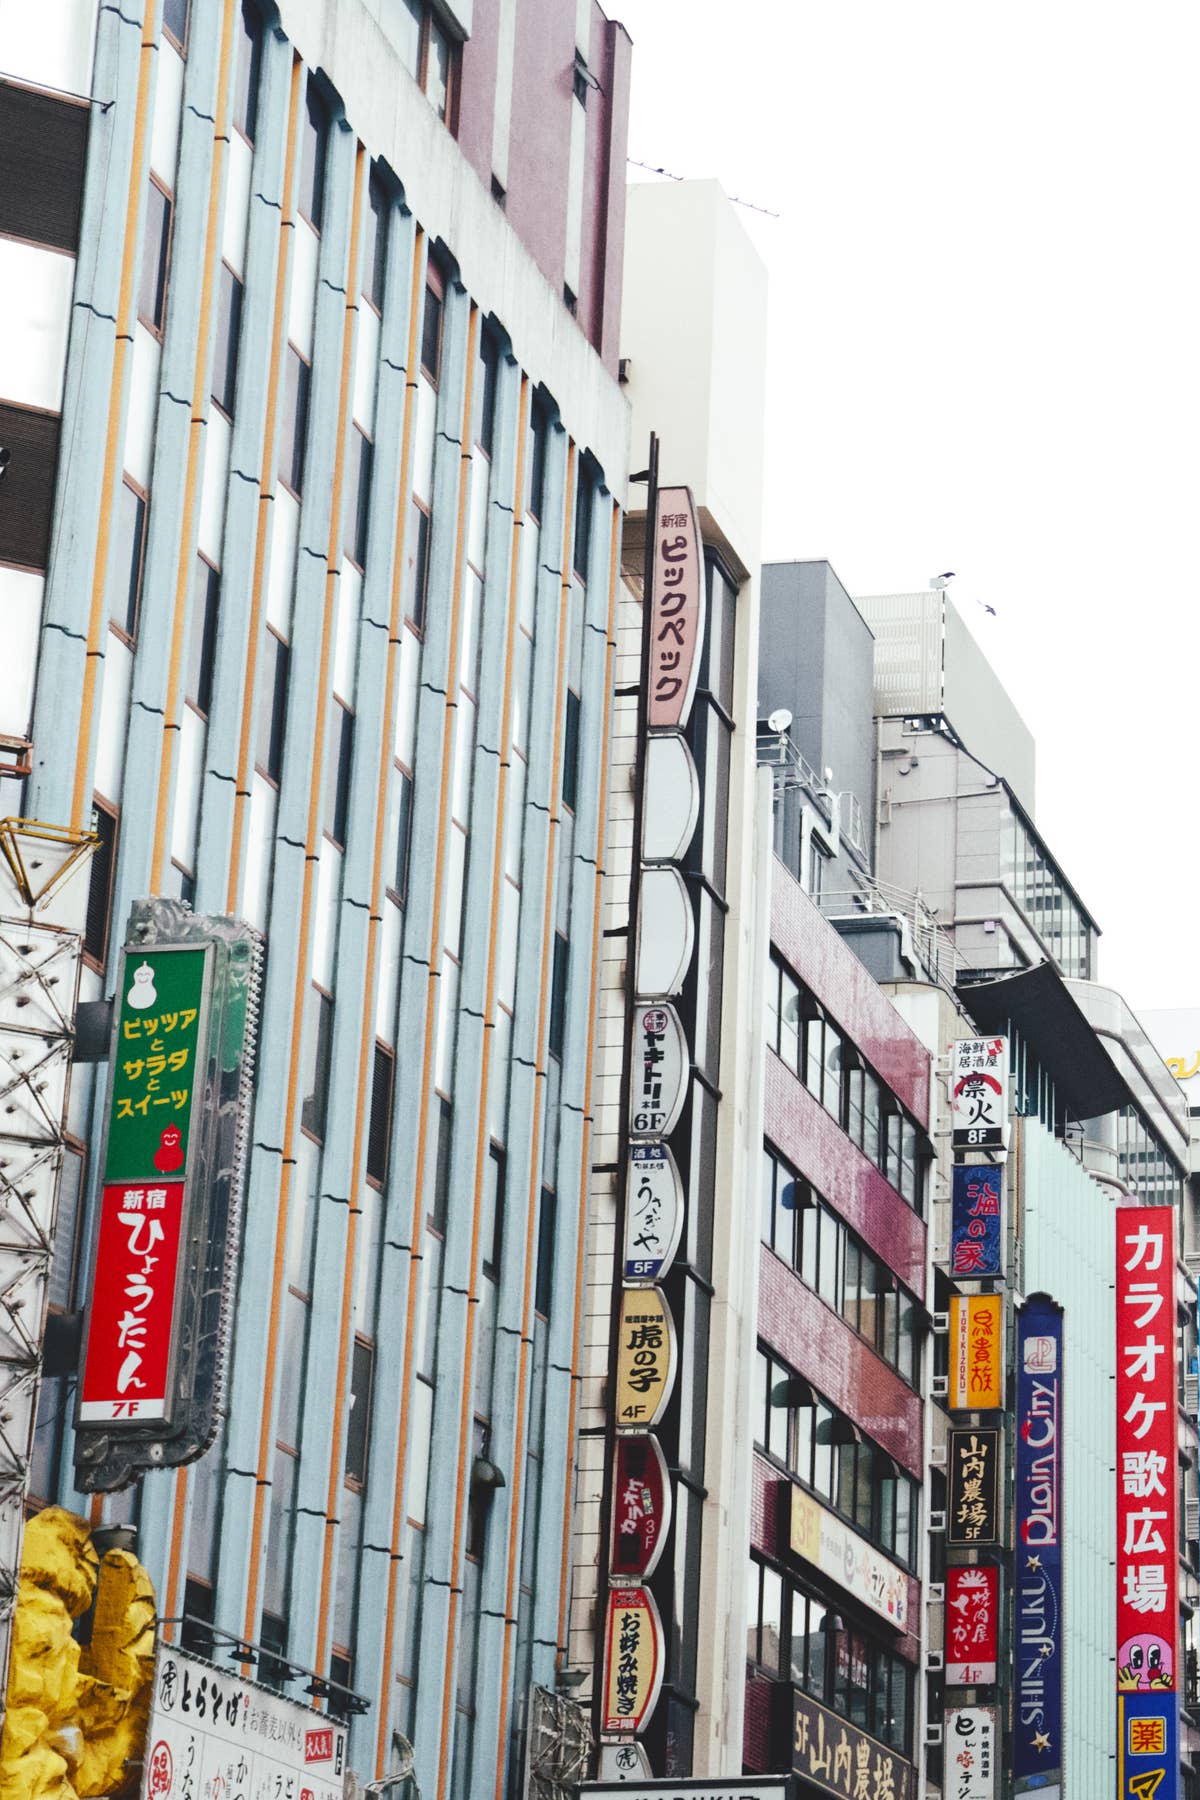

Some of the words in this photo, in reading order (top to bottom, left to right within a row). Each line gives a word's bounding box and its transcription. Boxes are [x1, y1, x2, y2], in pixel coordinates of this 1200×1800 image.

[661, 513, 688, 528] 新宿
[150, 1038, 162, 1052] と
[959, 1042, 985, 1055] 海鮮
[122, 1047, 190, 1080] サラダ
[643, 1031, 665, 1100] ヤキトリ
[959, 1055, 998, 1068] 居酒屋
[147, 1078, 160, 1092] と
[116, 1088, 189, 1119] スイーツ
[634, 1112, 666, 1130] 6F
[967, 1131, 987, 1144] 8F
[122, 1190, 167, 1210] 新宿
[953, 1183, 1001, 1274] 海の家
[634, 1261, 654, 1274] 5F
[116, 1211, 165, 1390] ひょうたん
[626, 1325, 663, 1393] 虎の子
[111, 1401, 139, 1418] 7F
[622, 1405, 646, 1418] 4F
[1122, 1225, 1168, 1613] カラオケ歌広場
[957, 1435, 988, 1527] 山内農場
[965, 1527, 981, 1539] 5F
[950, 1594, 971, 1659] さかい
[1021, 1576, 1055, 1725] SHINJUKU
[616, 1612, 641, 1716] お好み焼き
[959, 1666, 983, 1684] 4F
[181, 1669, 243, 1727] とらそば
[606, 1718, 635, 1729] 2階
[1132, 1721, 1162, 1751] 薬
[618, 1748, 638, 1769] 虎
[810, 1712, 895, 1800] 山内農場
